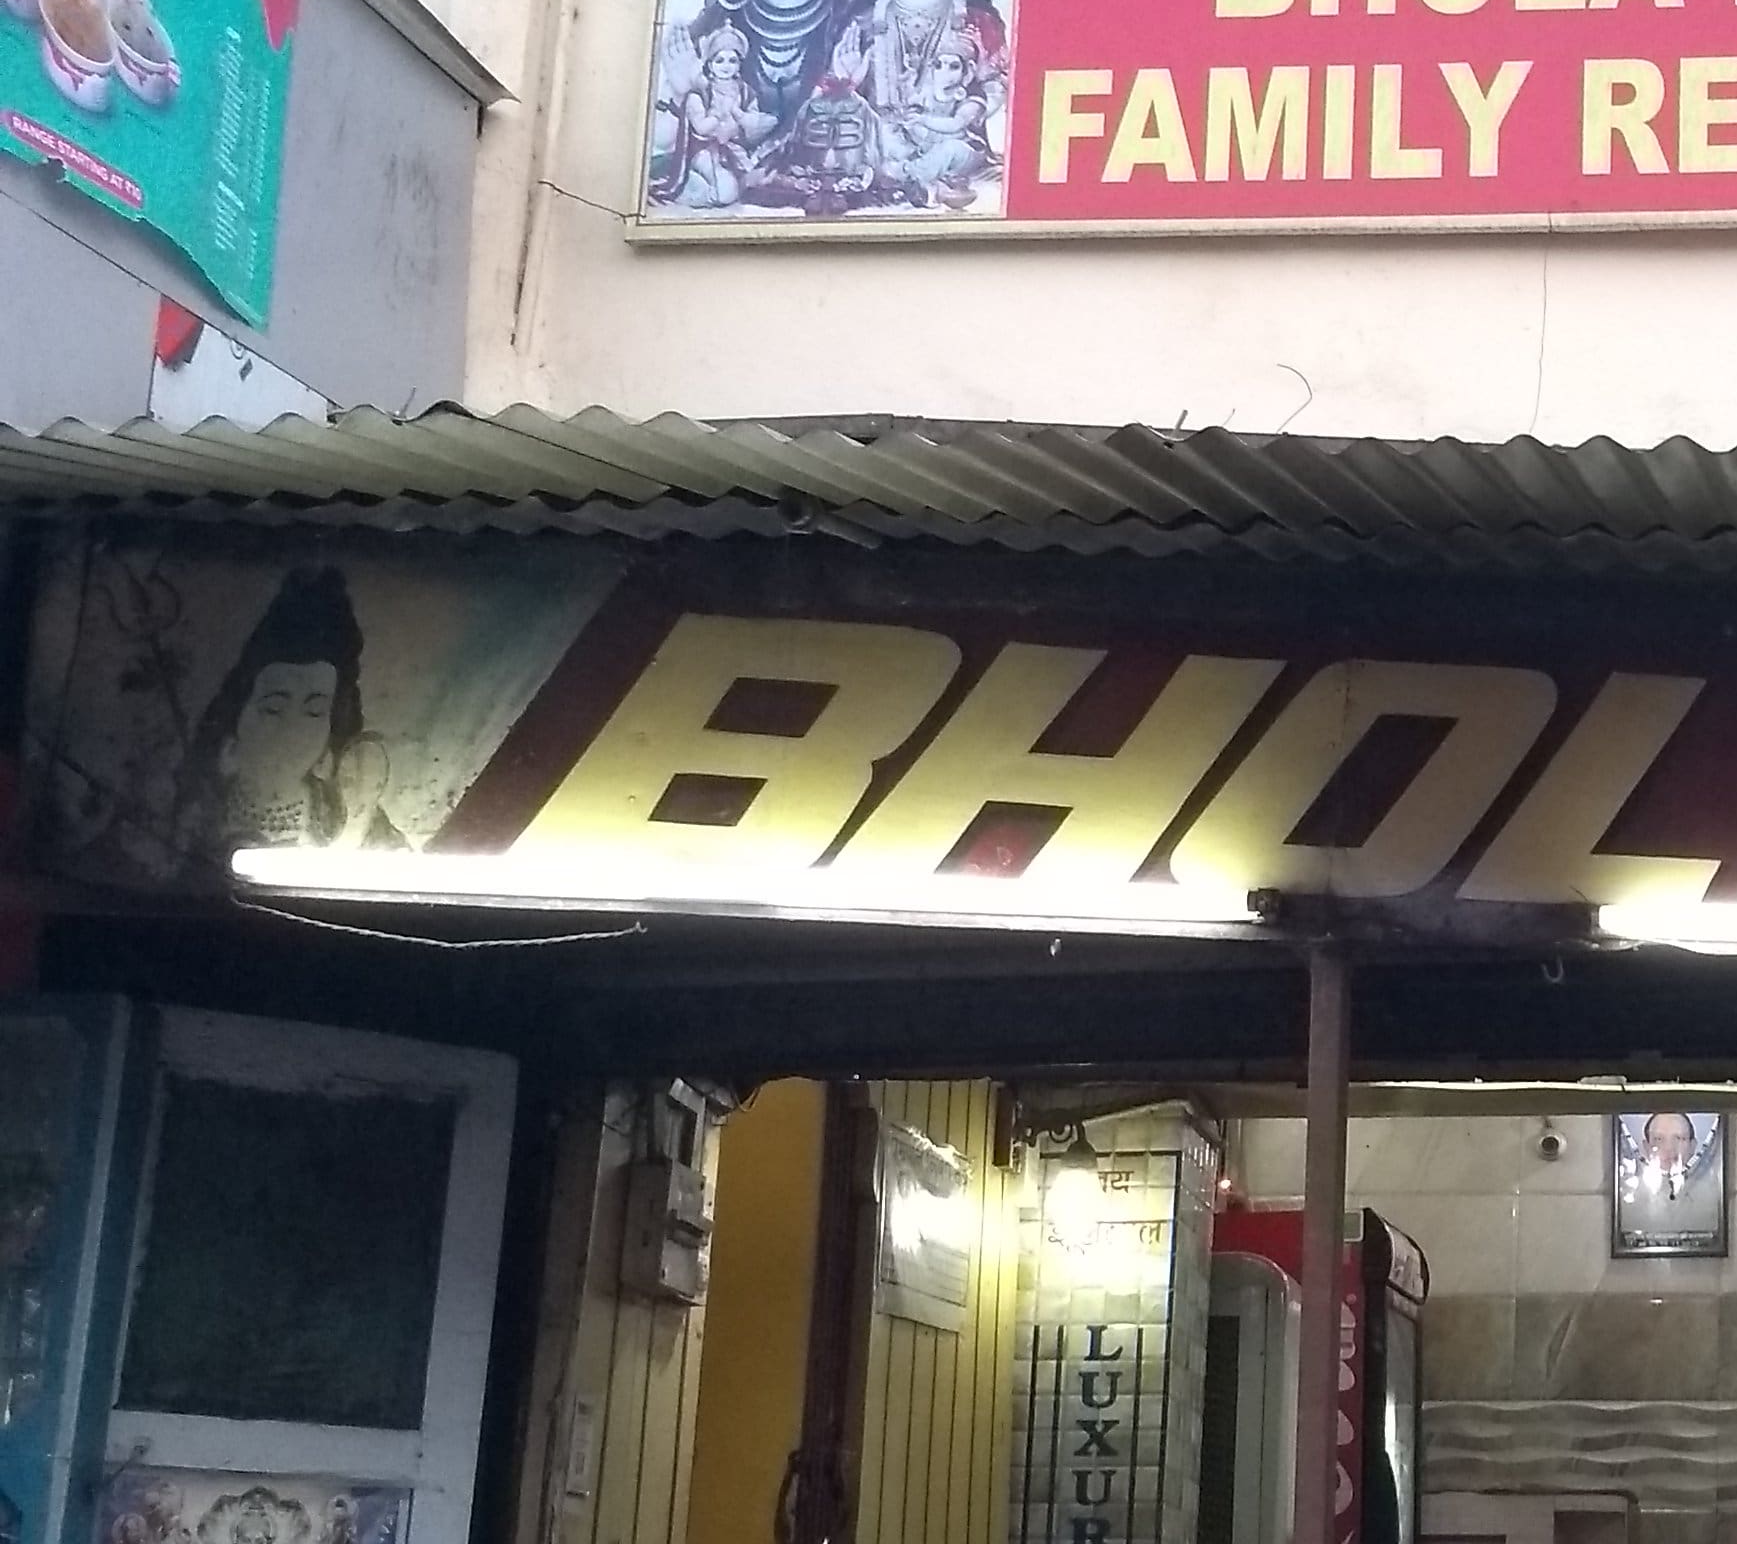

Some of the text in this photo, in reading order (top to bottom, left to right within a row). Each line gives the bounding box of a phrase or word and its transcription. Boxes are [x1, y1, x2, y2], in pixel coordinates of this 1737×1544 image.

[12, 116, 56, 149] RANGE
[57, 140, 109, 181] STARTING
[109, 174, 124, 190] AT
[1036, 59, 1534, 186] FAMILY
